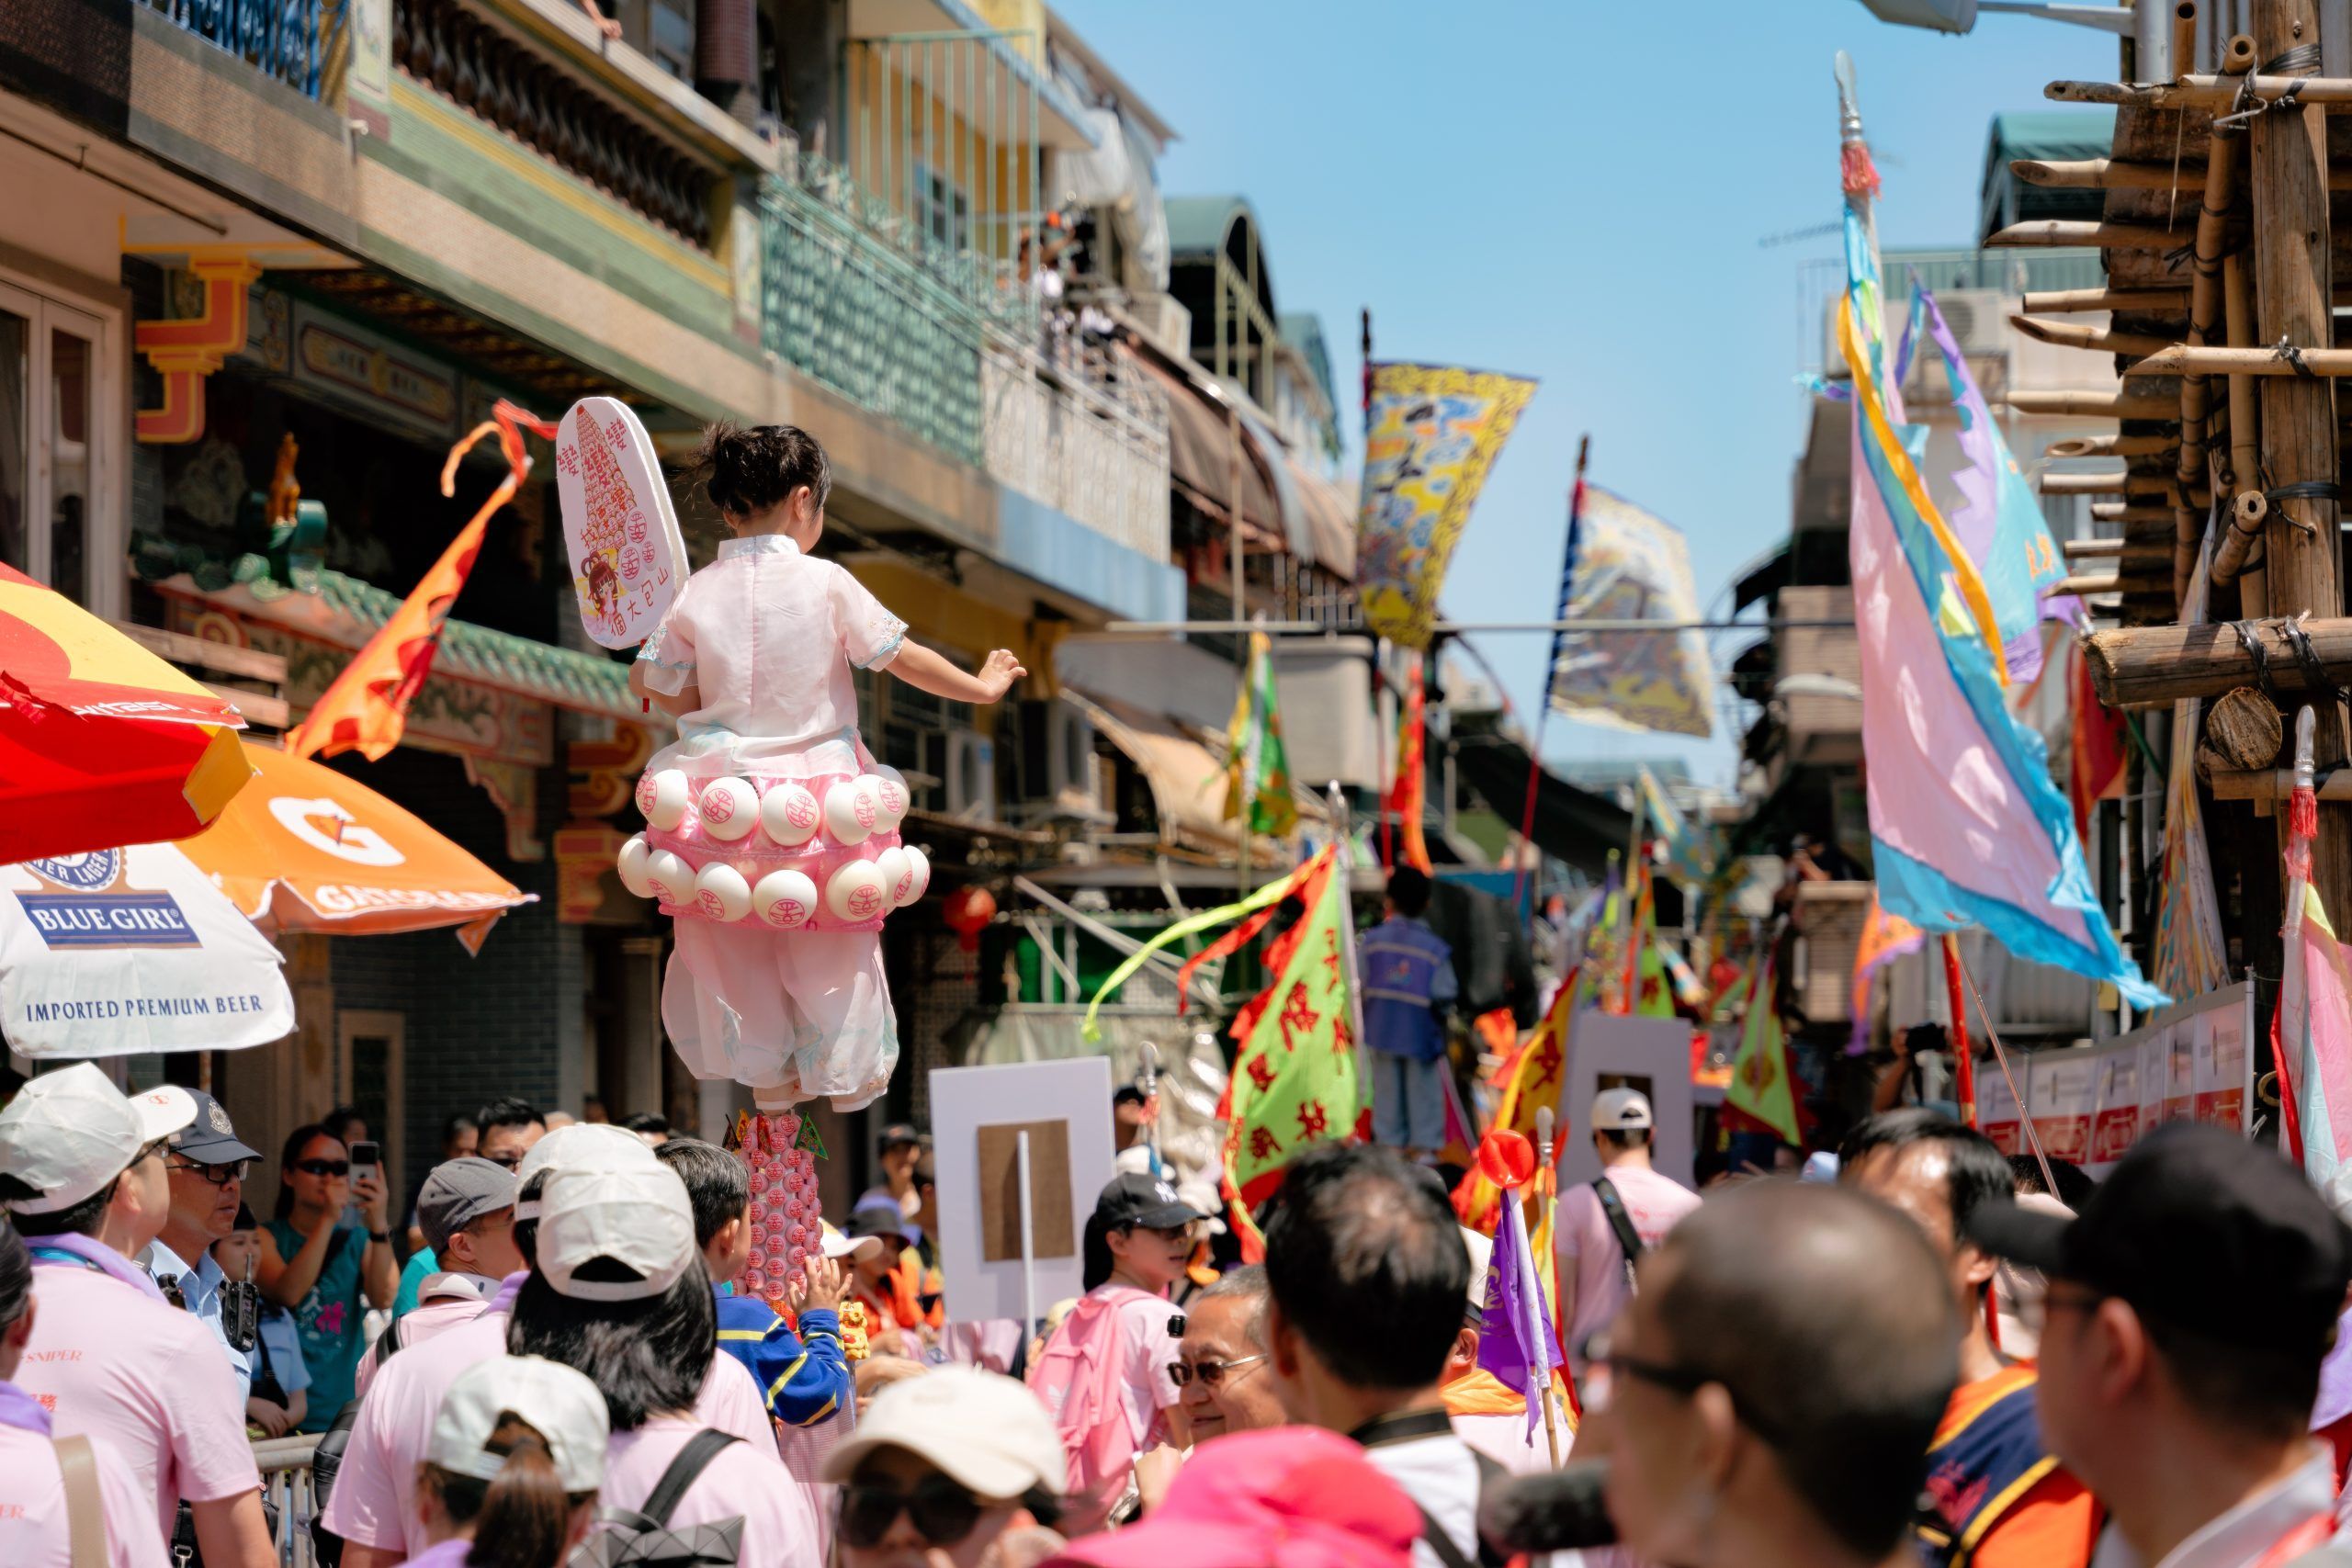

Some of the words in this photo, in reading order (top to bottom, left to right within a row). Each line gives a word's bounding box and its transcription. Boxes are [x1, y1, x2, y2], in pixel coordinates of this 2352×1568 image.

[74, 852, 108, 884] LAGER
[31, 908, 111, 931] BLUE
[26, 1000, 119, 1022] IMPORTED
[125, 998, 210, 1017] PREMIUM
[217, 995, 263, 1013] BEER
[26, 1349, 83, 1362] SNIPER
